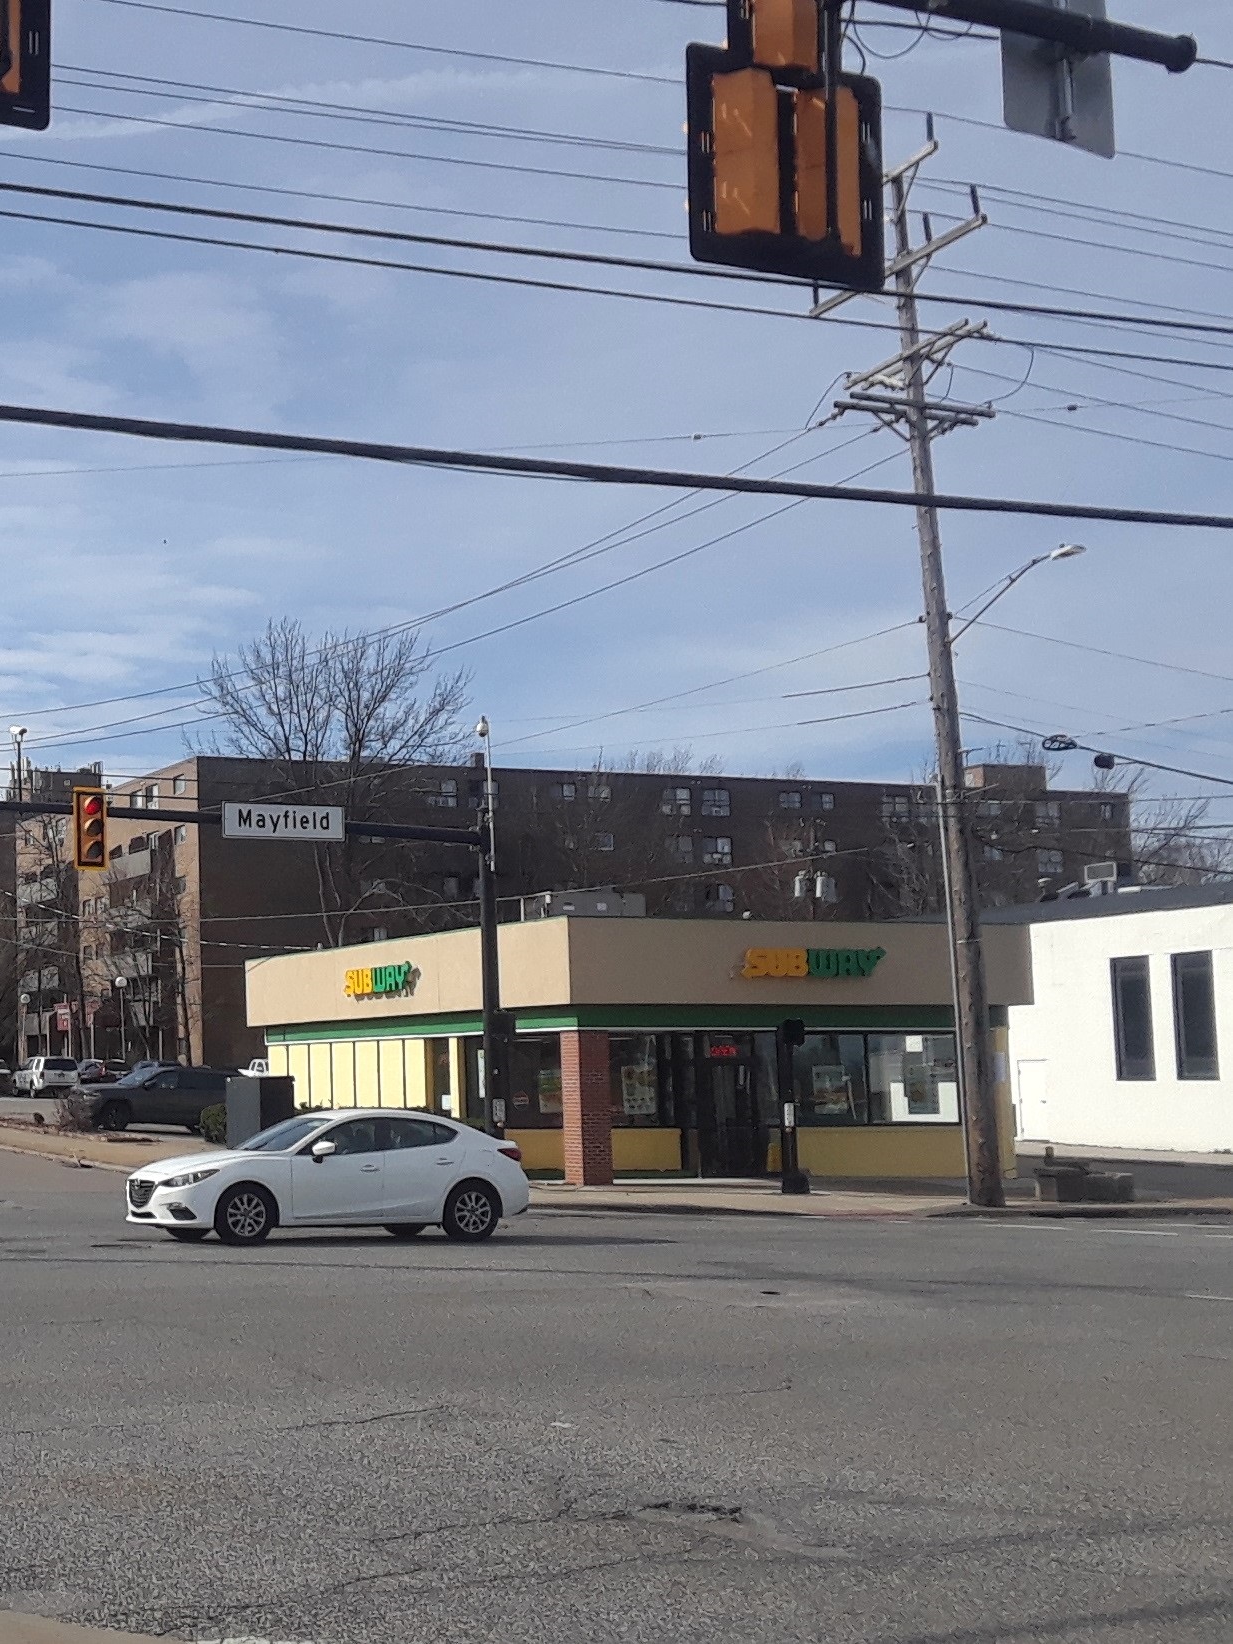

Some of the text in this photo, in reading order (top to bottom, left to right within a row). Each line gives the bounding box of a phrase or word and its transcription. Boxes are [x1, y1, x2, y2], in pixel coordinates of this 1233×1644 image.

[238, 808, 330, 833] Mayfield
[344, 960, 412, 995] SUBWAY
[741, 946, 887, 979] SUBWAY
